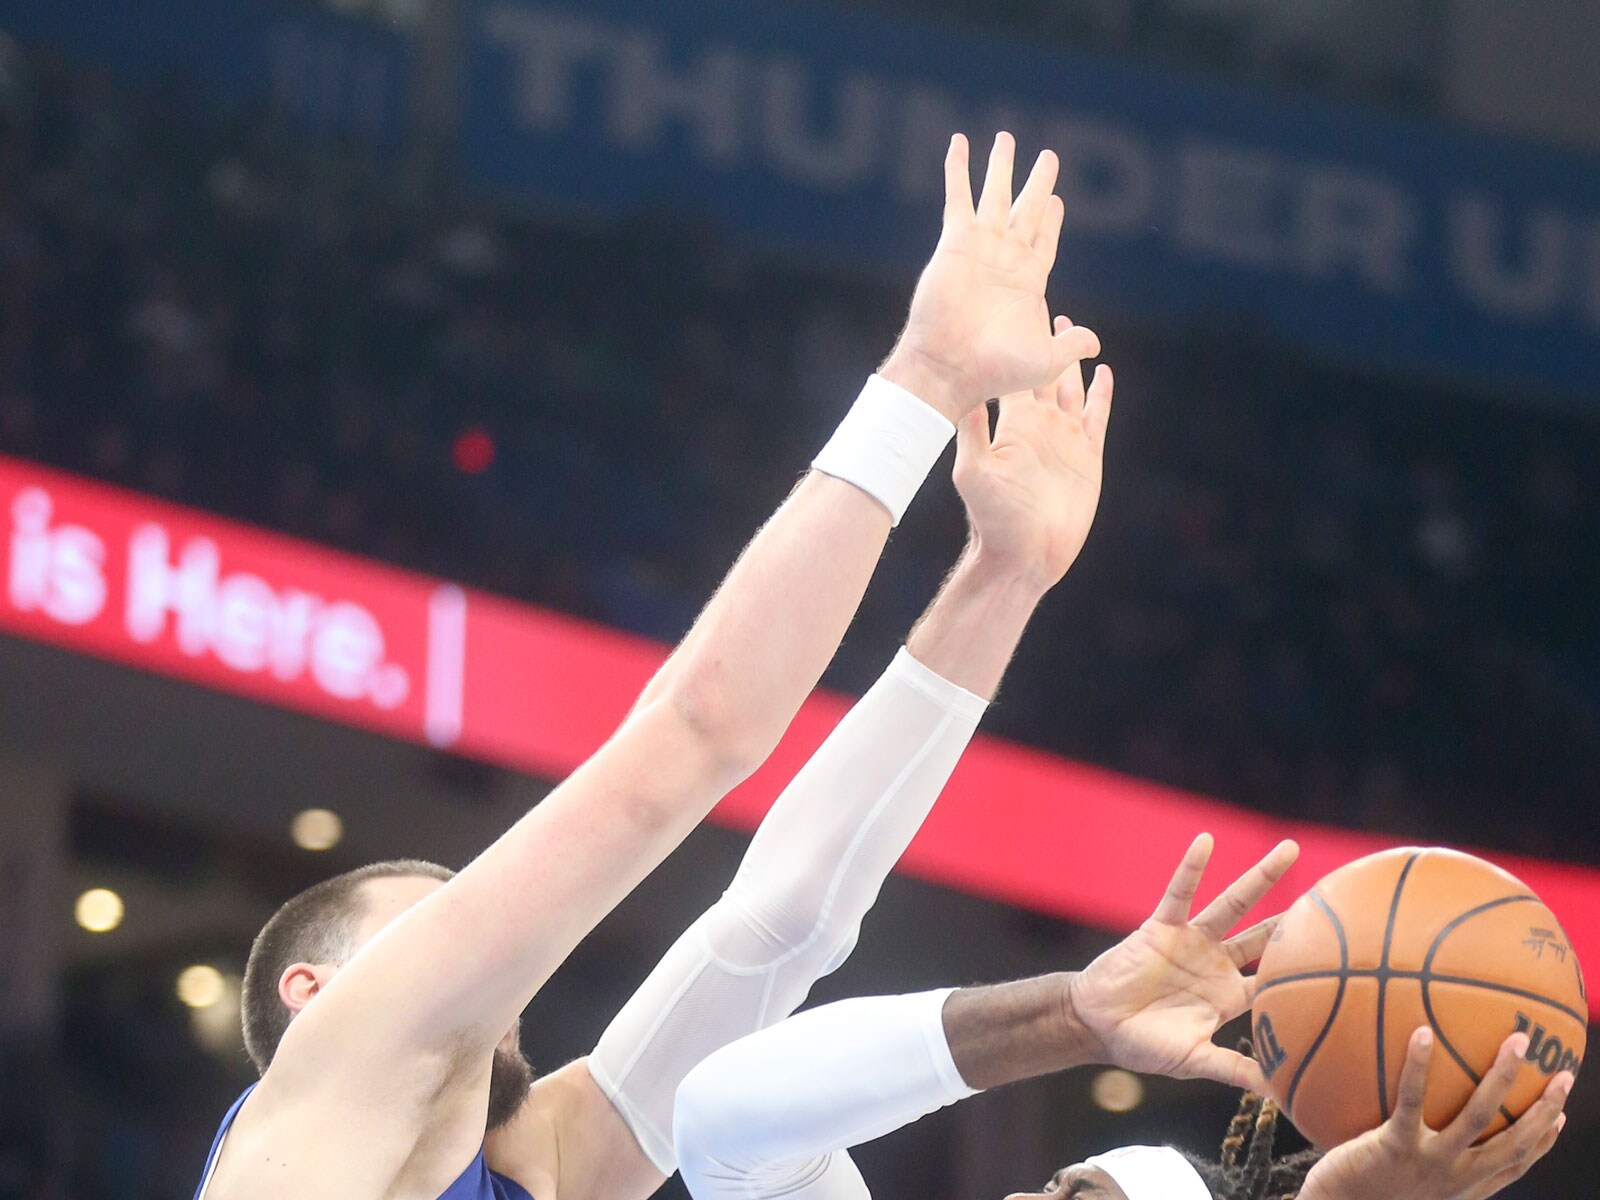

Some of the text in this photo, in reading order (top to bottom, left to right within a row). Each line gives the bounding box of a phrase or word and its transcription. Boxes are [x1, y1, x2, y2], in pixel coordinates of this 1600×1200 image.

[482, 8, 1418, 293] THUNDER
[9, 487, 410, 710] is Here.
